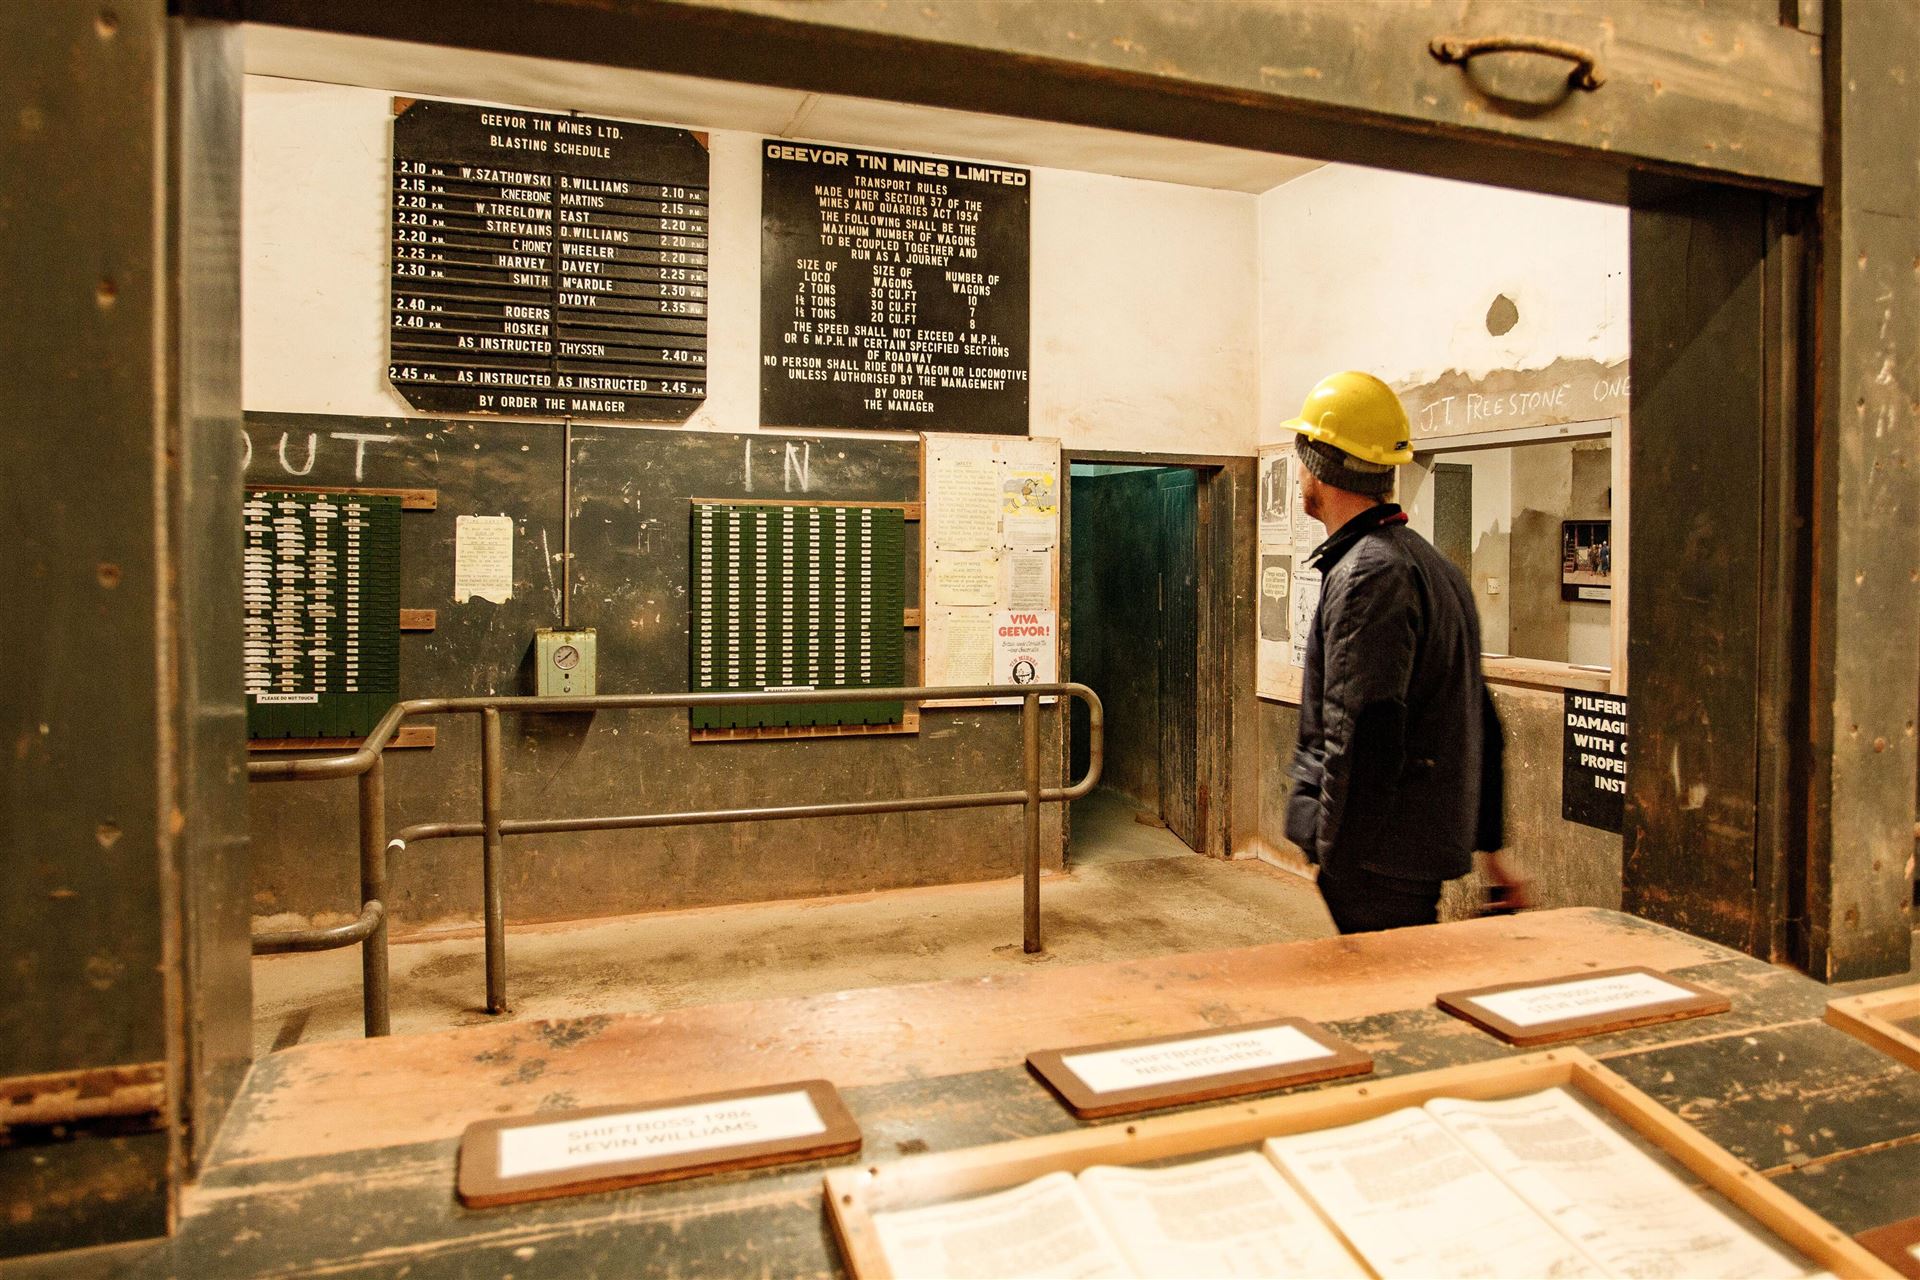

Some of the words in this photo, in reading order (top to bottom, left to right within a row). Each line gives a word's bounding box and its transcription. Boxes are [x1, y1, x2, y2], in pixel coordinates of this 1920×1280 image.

[480, 113, 526, 129] GEEVOR
[532, 118, 551, 131] TIN
[557, 120, 592, 136] MINES
[597, 125, 623, 140] LTD.
[490, 135, 547, 151] BLASTING
[553, 142, 611, 158] SCHEDULE
[767, 145, 849, 166] GEEVOR
[855, 154, 887, 170] TIN
[893, 158, 949, 177] MINES
[955, 165, 1027, 186] LIMITED
[560, 176, 629, 194] B.WILLIAMS
[854, 175, 911, 191] TRANSPORT
[916, 182, 948, 195] RULES
[501, 188, 552, 203] KNEEBONE
[560, 193, 604, 208] MARTINS
[814, 185, 842, 197] MADE
[847, 188, 879, 201] UNDER
[884, 191, 925, 205] SECTION
[930, 196, 942, 207] 37
[947, 198, 959, 209] OF
[964, 199, 982, 212] THE
[475, 202, 552, 220] W.TREGLOWN
[560, 210, 590, 223] EAST
[819, 196, 849, 209] MINES
[854, 200, 874, 212] AND
[879, 202, 928, 217] QUARRIES
[932, 207, 951, 219] ACT
[956, 209, 979, 222] 1954
[486, 220, 552, 236] S.TREVAINS
[820, 210, 839, 222] THE
[844, 212, 900, 228] FOLLOWING
[905, 218, 937, 232] SHALL
[941, 222, 954, 233] BE
[958, 223, 977, 236] THE
[560, 226, 629, 243] D.WILLIAMS
[822, 222, 869, 236] MAXIMUM
[875, 227, 914, 241] NUMBER
[919, 231, 932, 242] OF
[937, 233, 976, 247] WAGONS
[521, 239, 552, 253] HONEY
[561, 243, 614, 258] WHEELER
[820, 234, 833, 246] TO
[838, 235, 851, 247] BE
[855, 237, 899, 251] COUPLED
[904, 241, 954, 256] TOGETHER
[958, 247, 978, 259] AND
[498, 255, 545, 270] HARVEY
[796, 258, 820, 270] SIZE
[824, 260, 838, 272] OF
[850, 248, 870, 260] RUN
[875, 250, 889, 262] AS
[893, 251, 901, 263] A
[905, 253, 949, 267] JOURNEY
[562, 260, 600, 274] DAVEY
[872, 264, 895, 276] SIZE
[899, 266, 912, 278] OF
[513, 273, 548, 286] SMITH
[562, 276, 613, 291] McARDLE
[804, 270, 830, 283] LOCO
[872, 276, 913, 290] WAGONS
[945, 271, 983, 284] NUMBER
[987, 274, 1000, 285] OF
[798, 282, 805, 293] 2
[810, 282, 836, 295] TONS
[868, 287, 883, 299] 30
[888, 288, 917, 301] CU.FT
[951, 282, 991, 296] WAGONS
[559, 293, 596, 307] DYDYK
[810, 295, 836, 307] TONS
[870, 299, 884, 311] 30
[888, 301, 917, 313] CU.FT
[967, 295, 977, 306] 10
[505, 305, 550, 320] ROGERS
[810, 307, 836, 319] TONS
[870, 311, 884, 323] 20
[888, 312, 917, 325] CU.FT
[969, 306, 975, 317] 7
[504, 322, 549, 336] HOSKEN
[969, 318, 976, 330] 8
[792, 320, 812, 333] THE
[817, 322, 849, 335] SPEED
[854, 325, 887, 337] SHALL
[892, 327, 911, 339] NOT
[917, 329, 954, 342] EXCEED
[958, 332, 966, 343] 4
[970, 333, 1001, 346] M.P.H.
[457, 336, 474, 348] AS
[480, 337, 551, 353] INSTRUCTED
[559, 342, 605, 356] THYSSEN
[783, 332, 797, 344] OR
[802, 333, 810, 344] 6
[814, 334, 845, 346] M.P.H.
[847, 336, 858, 347] IN
[863, 337, 906, 350] CERTAIN
[909, 340, 959, 354] SPECIFIED
[963, 344, 1010, 357] SECTIONS
[866, 349, 880, 360] OF
[884, 350, 932, 363] ROADWAY
[763, 354, 777, 367] NO
[781, 356, 821, 368] PERSON
[826, 358, 859, 371] SHALL
[864, 360, 887, 372] RIDE
[890, 362, 904, 373] ON
[906, 363, 913, 374] A
[915, 364, 949, 376] WAGON
[952, 366, 964, 377] OR
[968, 367, 1027, 381] LOCOMOTIVE
[457, 370, 473, 382] AS
[479, 372, 552, 387] INSTRUCTED
[557, 375, 573, 388] AS
[578, 377, 648, 392] INSTRUCTED
[788, 368, 827, 381] UNLESS
[833, 370, 896, 384] AUTHORISED
[900, 374, 913, 385] BY
[918, 375, 936, 387] THE
[941, 377, 1005, 390] MANAGEMENT
[874, 387, 887, 399] BY
[892, 388, 924, 400] ORDER
[479, 394, 494, 407] BY
[500, 396, 537, 408] ORDER
[544, 397, 566, 410] THE
[571, 399, 625, 412] MANAGER
[863, 398, 883, 410] THE
[887, 399, 934, 412] MANAGER
[1467, 384, 1572, 424] FREESTONE
[745, 438, 809, 493] IN
[1010, 614, 1038, 625] VIVA
[998, 625, 1050, 637] GEEVOR!
[1567, 713, 1628, 736] DAMAGI
[1573, 732, 1615, 753] WITH
[568, 1116, 696, 1140] SHIFTBOSS
[568, 1137, 638, 1155] KEVIN
[646, 1120, 759, 1145] WILLIAMS
